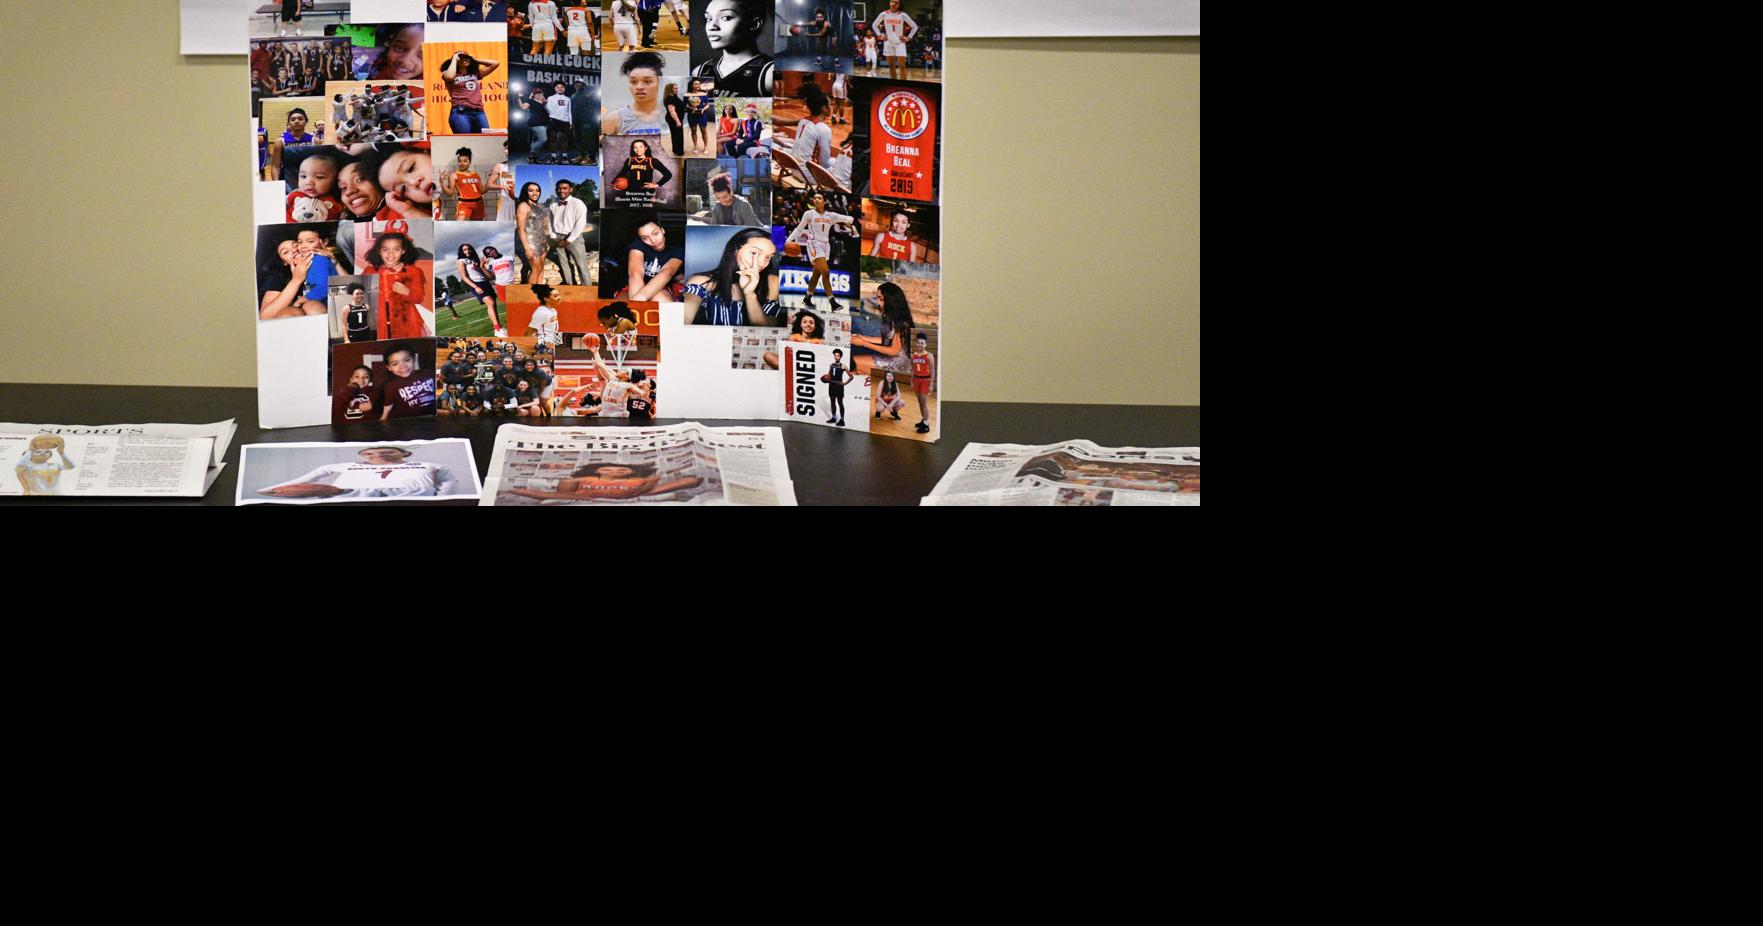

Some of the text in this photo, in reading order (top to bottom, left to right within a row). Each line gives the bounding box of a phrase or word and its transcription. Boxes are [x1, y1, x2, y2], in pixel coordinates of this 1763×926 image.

[572, 12, 579, 20] 2
[886, 143, 920, 156] BREANNA
[893, 155, 912, 168] BEAL
[636, 170, 640, 181] 1
[471, 183, 478, 193] 1
[889, 178, 914, 194] 2019
[887, 242, 906, 253] ROCK
[357, 311, 363, 324] 1
[796, 349, 816, 417] SIGNED
[631, 400, 646, 411] 52
